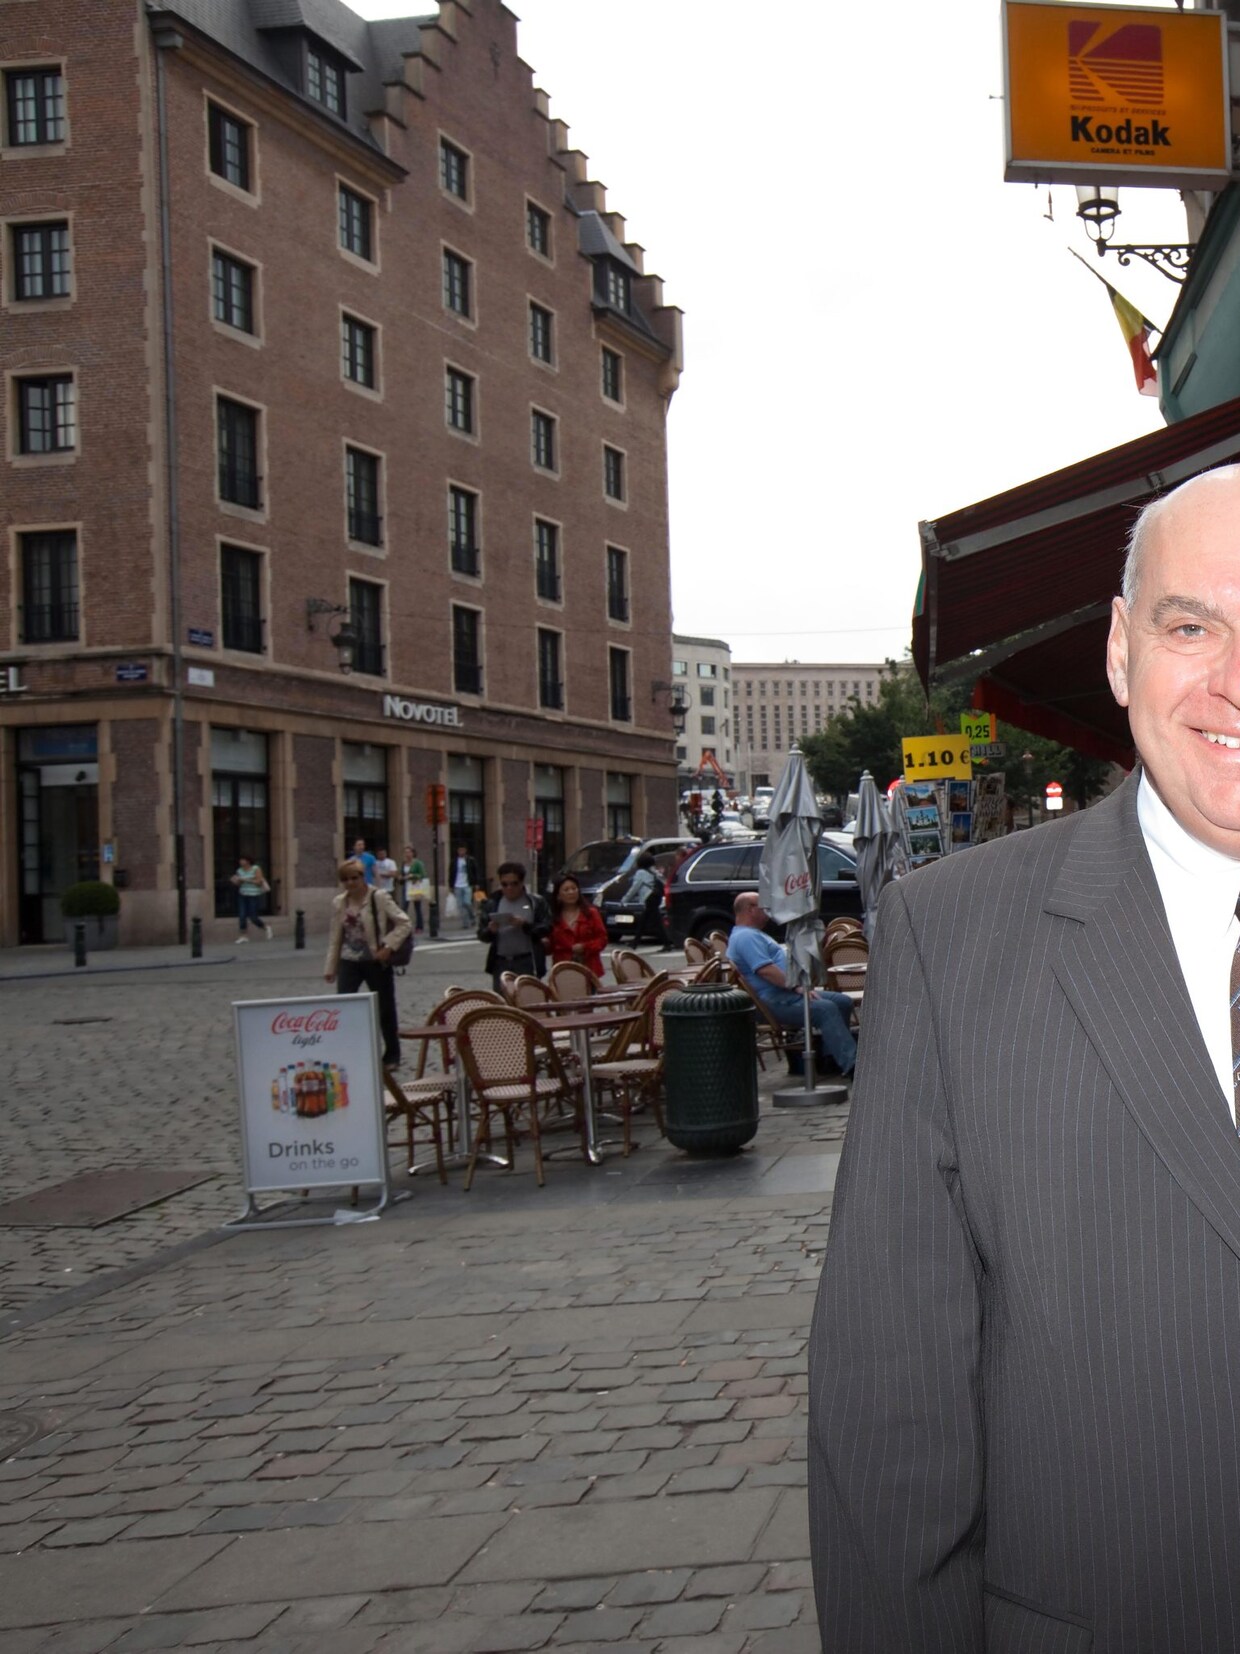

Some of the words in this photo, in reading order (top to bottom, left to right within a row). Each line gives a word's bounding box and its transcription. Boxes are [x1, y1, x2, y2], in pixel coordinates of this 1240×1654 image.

[1070, 115, 1172, 147] Kodak
[383, 694, 464, 728] NOVOTEL
[905, 750, 954, 768] 1.10
[960, 750, 971, 765] €
[271, 1009, 341, 1035] Coca-Cola
[292, 1034, 323, 1048] light
[269, 1140, 335, 1158] Drinks
[289, 1160, 308, 1171] on
[312, 1157, 336, 1170] the
[340, 1156, 360, 1170] go
